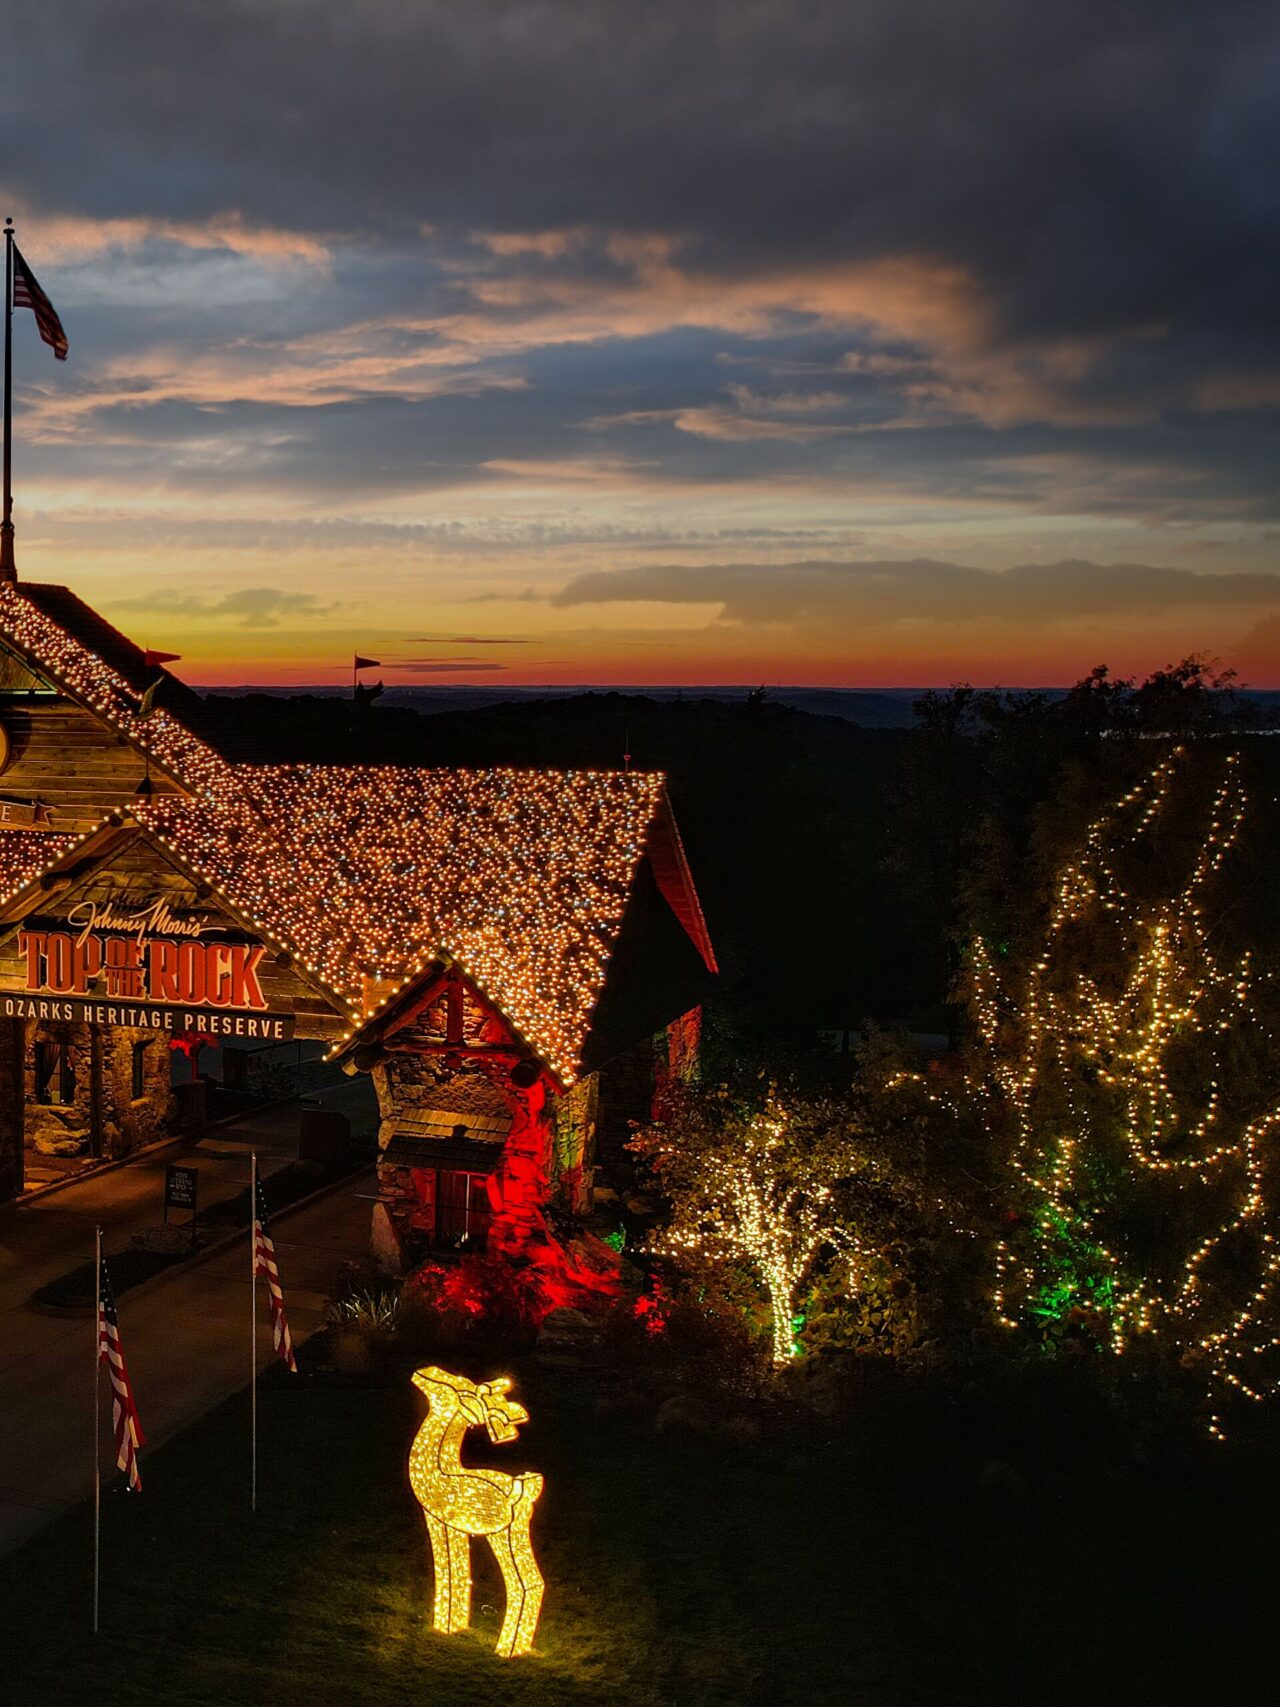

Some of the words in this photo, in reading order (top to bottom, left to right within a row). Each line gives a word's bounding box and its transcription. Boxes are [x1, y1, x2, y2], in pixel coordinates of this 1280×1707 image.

[67, 901, 148, 949] Johnny
[18, 930, 102, 996] TOP
[104, 936, 143, 968] OF
[104, 966, 146, 998] THE
[148, 940, 269, 1010] ROCK
[5, 999, 74, 1021] OZARKS
[83, 1004, 174, 1030] HERITAGE
[184, 1013, 285, 1039] PRESERVE
